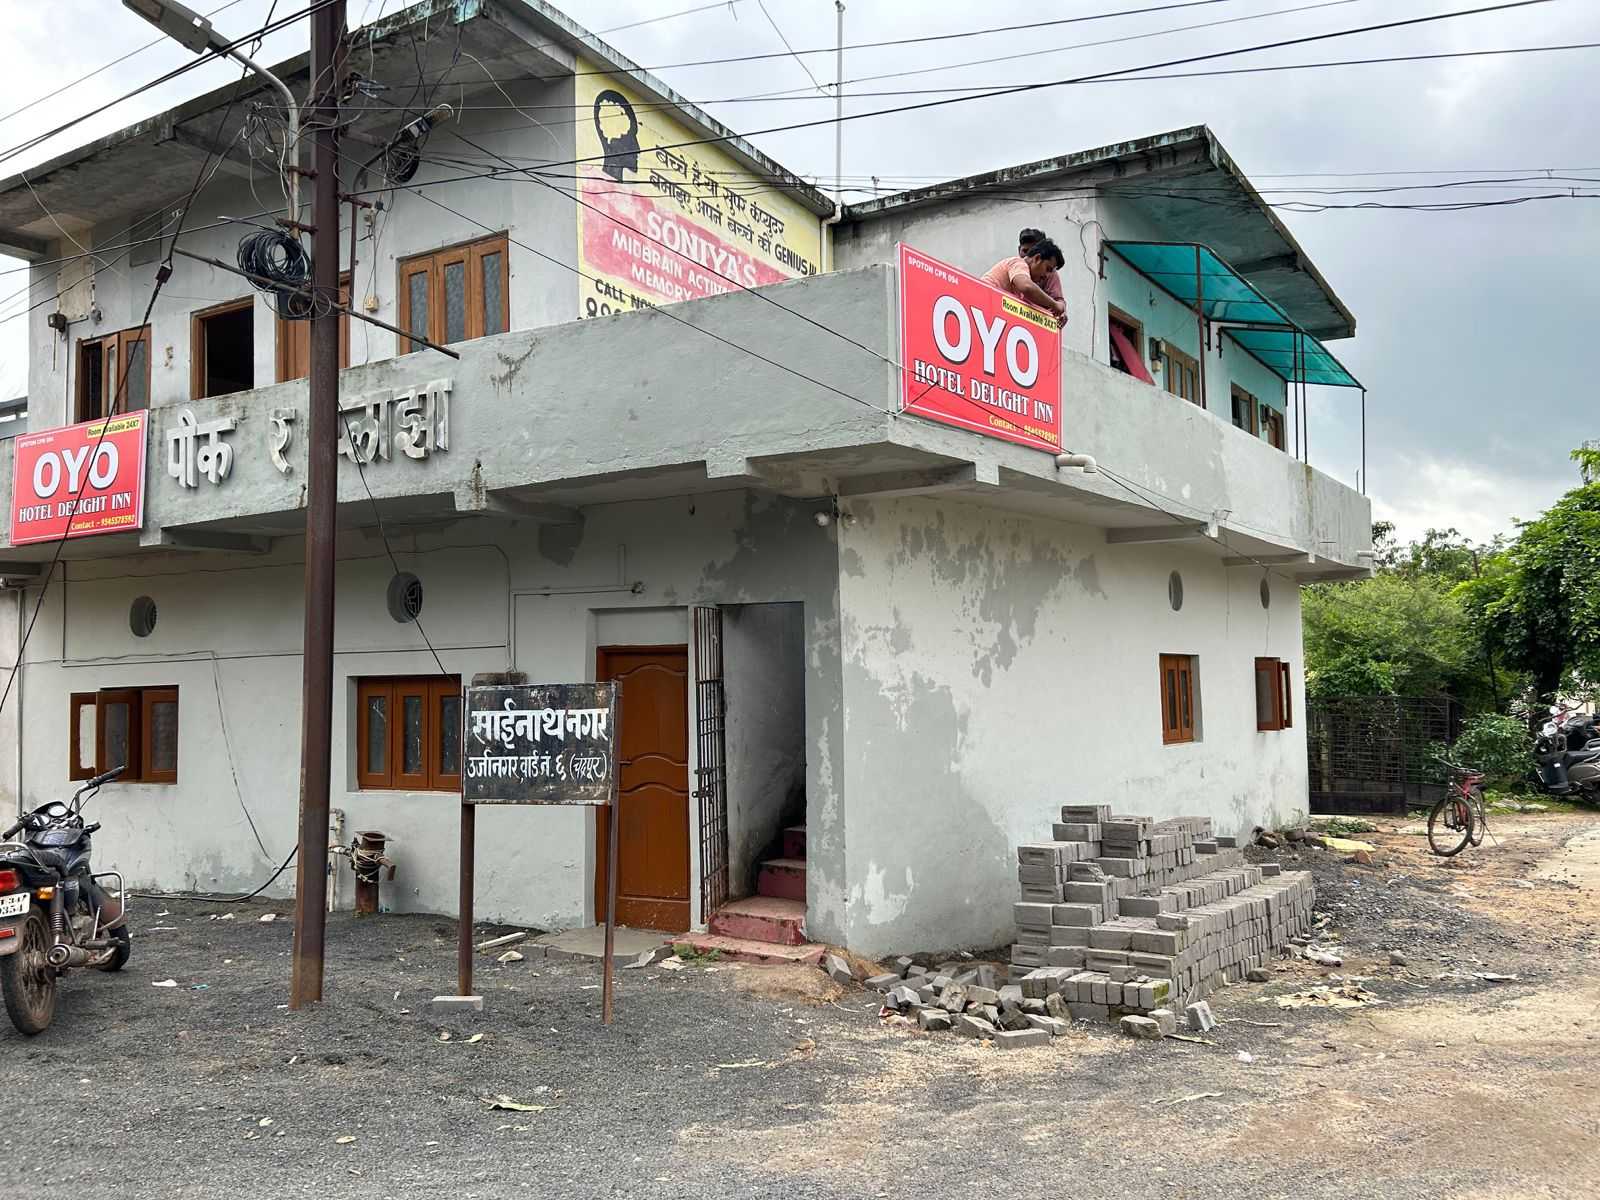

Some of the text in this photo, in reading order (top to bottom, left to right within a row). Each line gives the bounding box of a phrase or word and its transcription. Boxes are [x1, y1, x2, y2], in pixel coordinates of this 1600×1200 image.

[656, 145, 688, 179] बच्चे
[611, 228, 683, 280] MIDBRAIN
[646, 211, 757, 288] SONIYA'S
[727, 216, 754, 245] बच्चे
[758, 232, 771, 256] को
[774, 244, 808, 276] GENIUS
[595, 279, 626, 304] CALL
[631, 262, 692, 302] MEMORY
[1003, 299, 1019, 314] Room
[1019, 306, 1044, 326] Available
[932, 295, 1040, 390] OYO
[914, 359, 1055, 424] HOTEL DELIGHT INN
[989, 415, 1017, 432] Contact
[33, 440, 119, 499] OYO
[19, 492, 132, 523] HOTEL DELIGHT INN
[71, 520, 95, 531] Contact
[471, 697, 565, 749] साईनाथ
